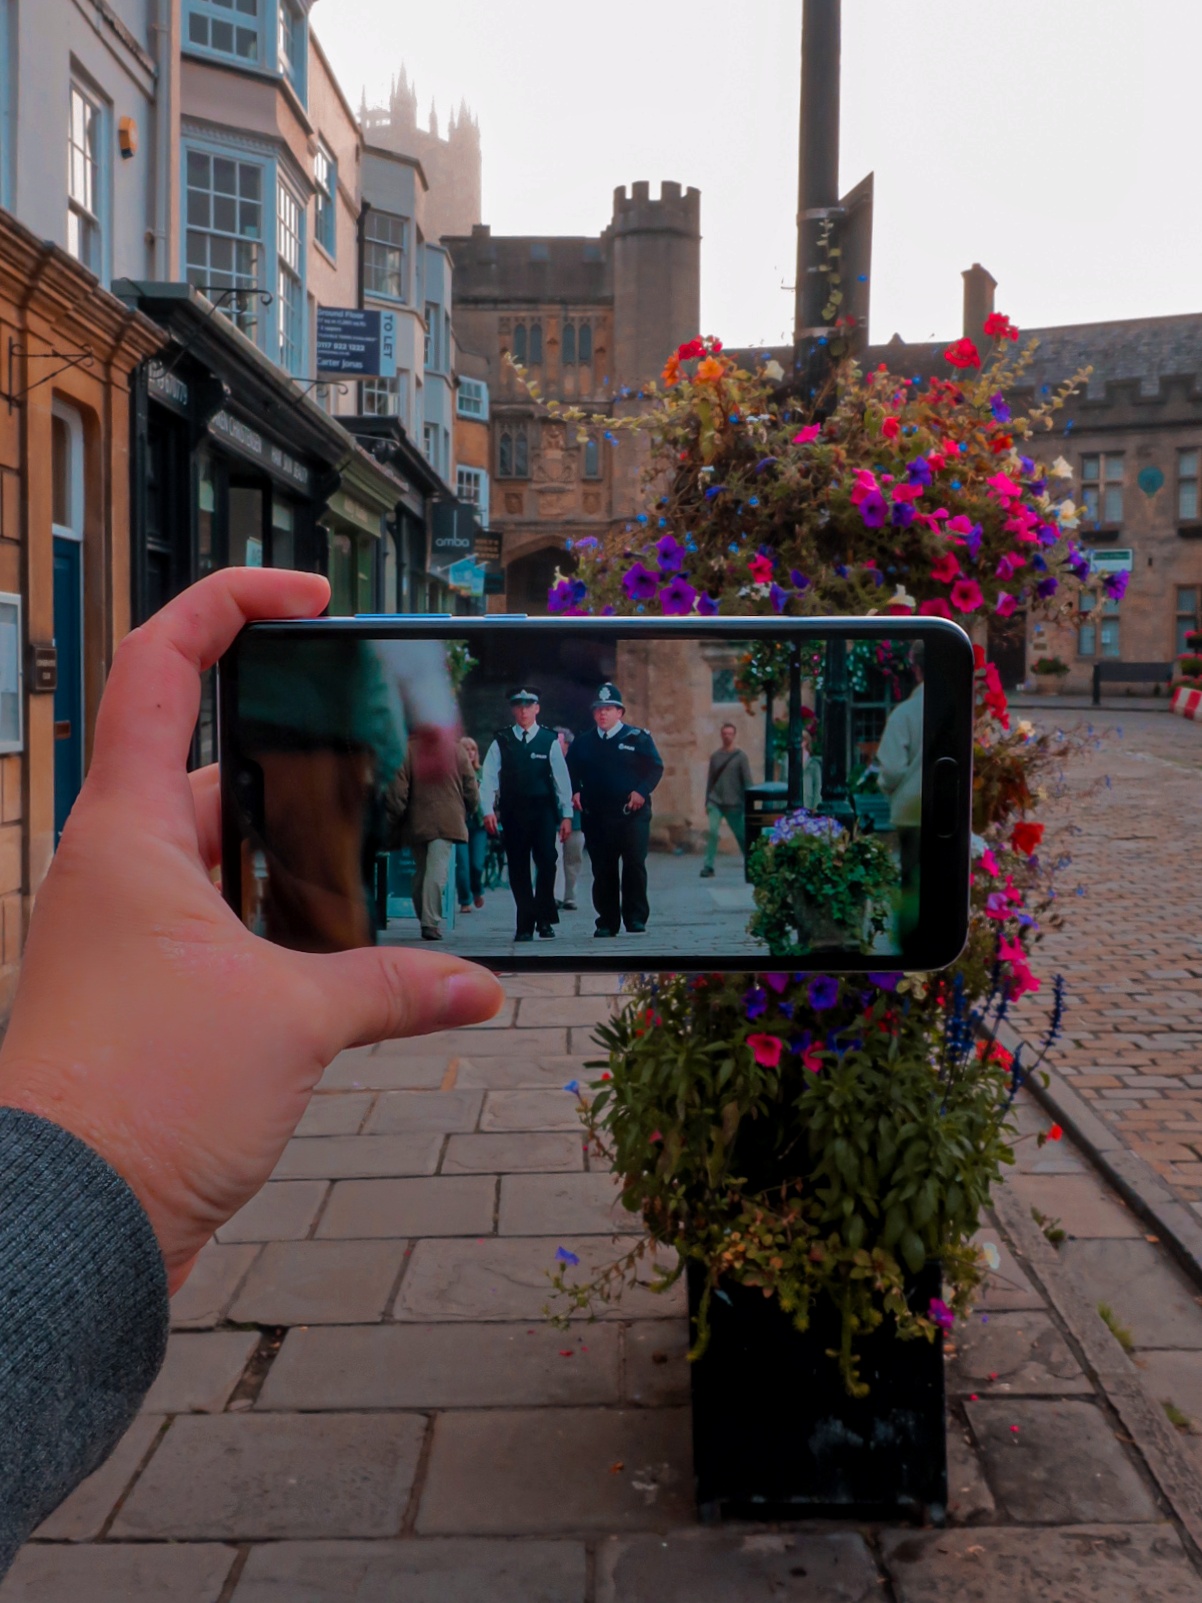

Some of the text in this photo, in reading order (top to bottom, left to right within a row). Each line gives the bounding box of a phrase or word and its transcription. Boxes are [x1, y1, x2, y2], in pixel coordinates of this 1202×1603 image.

[345, 311, 365, 319] Floor
[384, 315, 393, 359] TO LET
[348, 344, 365, 352] 1222
[317, 357, 363, 369] Carter Jonas
